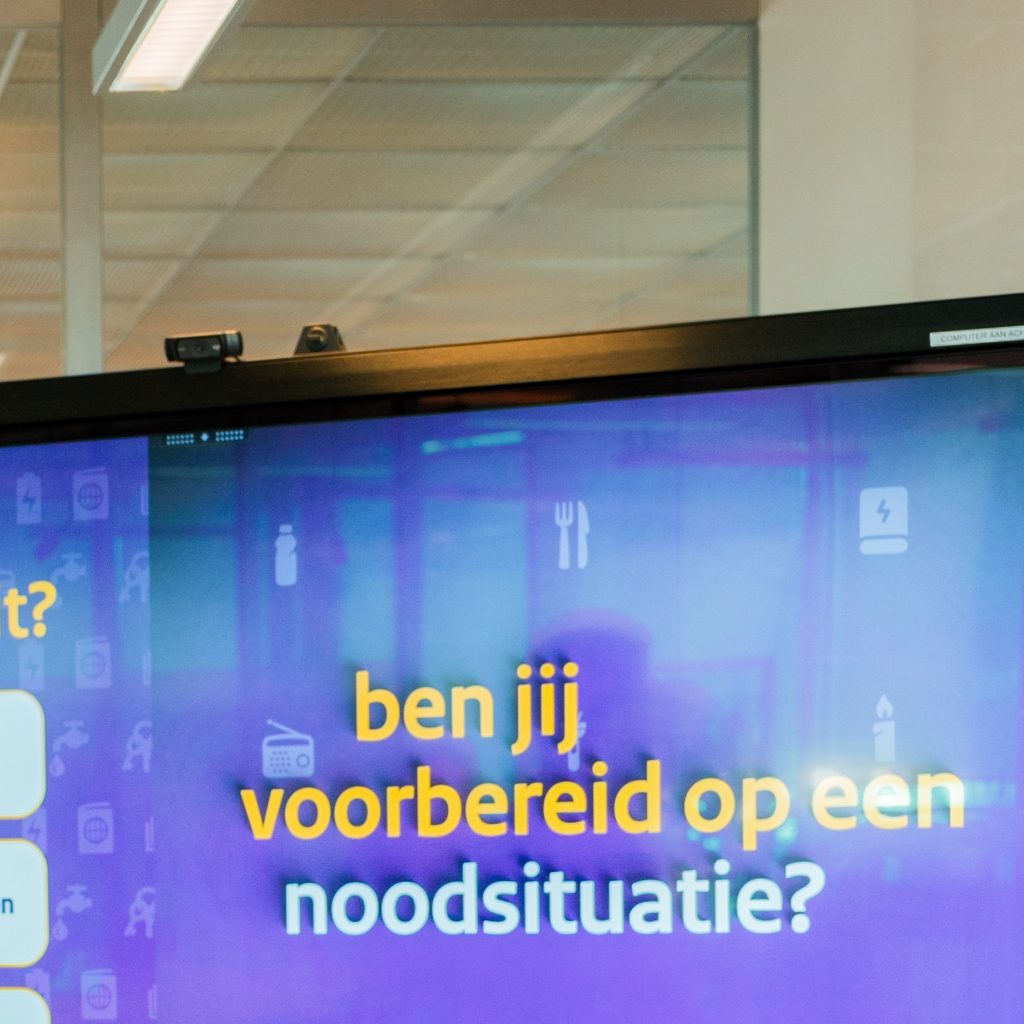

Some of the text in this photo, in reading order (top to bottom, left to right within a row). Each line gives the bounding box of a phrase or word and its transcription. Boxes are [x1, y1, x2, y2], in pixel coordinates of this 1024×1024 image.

[940, 332, 988, 343] COMPUTER
[989, 330, 1008, 339] AAN
[354, 662, 580, 755] ben jij
[240, 759, 966, 851] voorbereid op een
[283, 859, 826, 936] noodsituatie?
